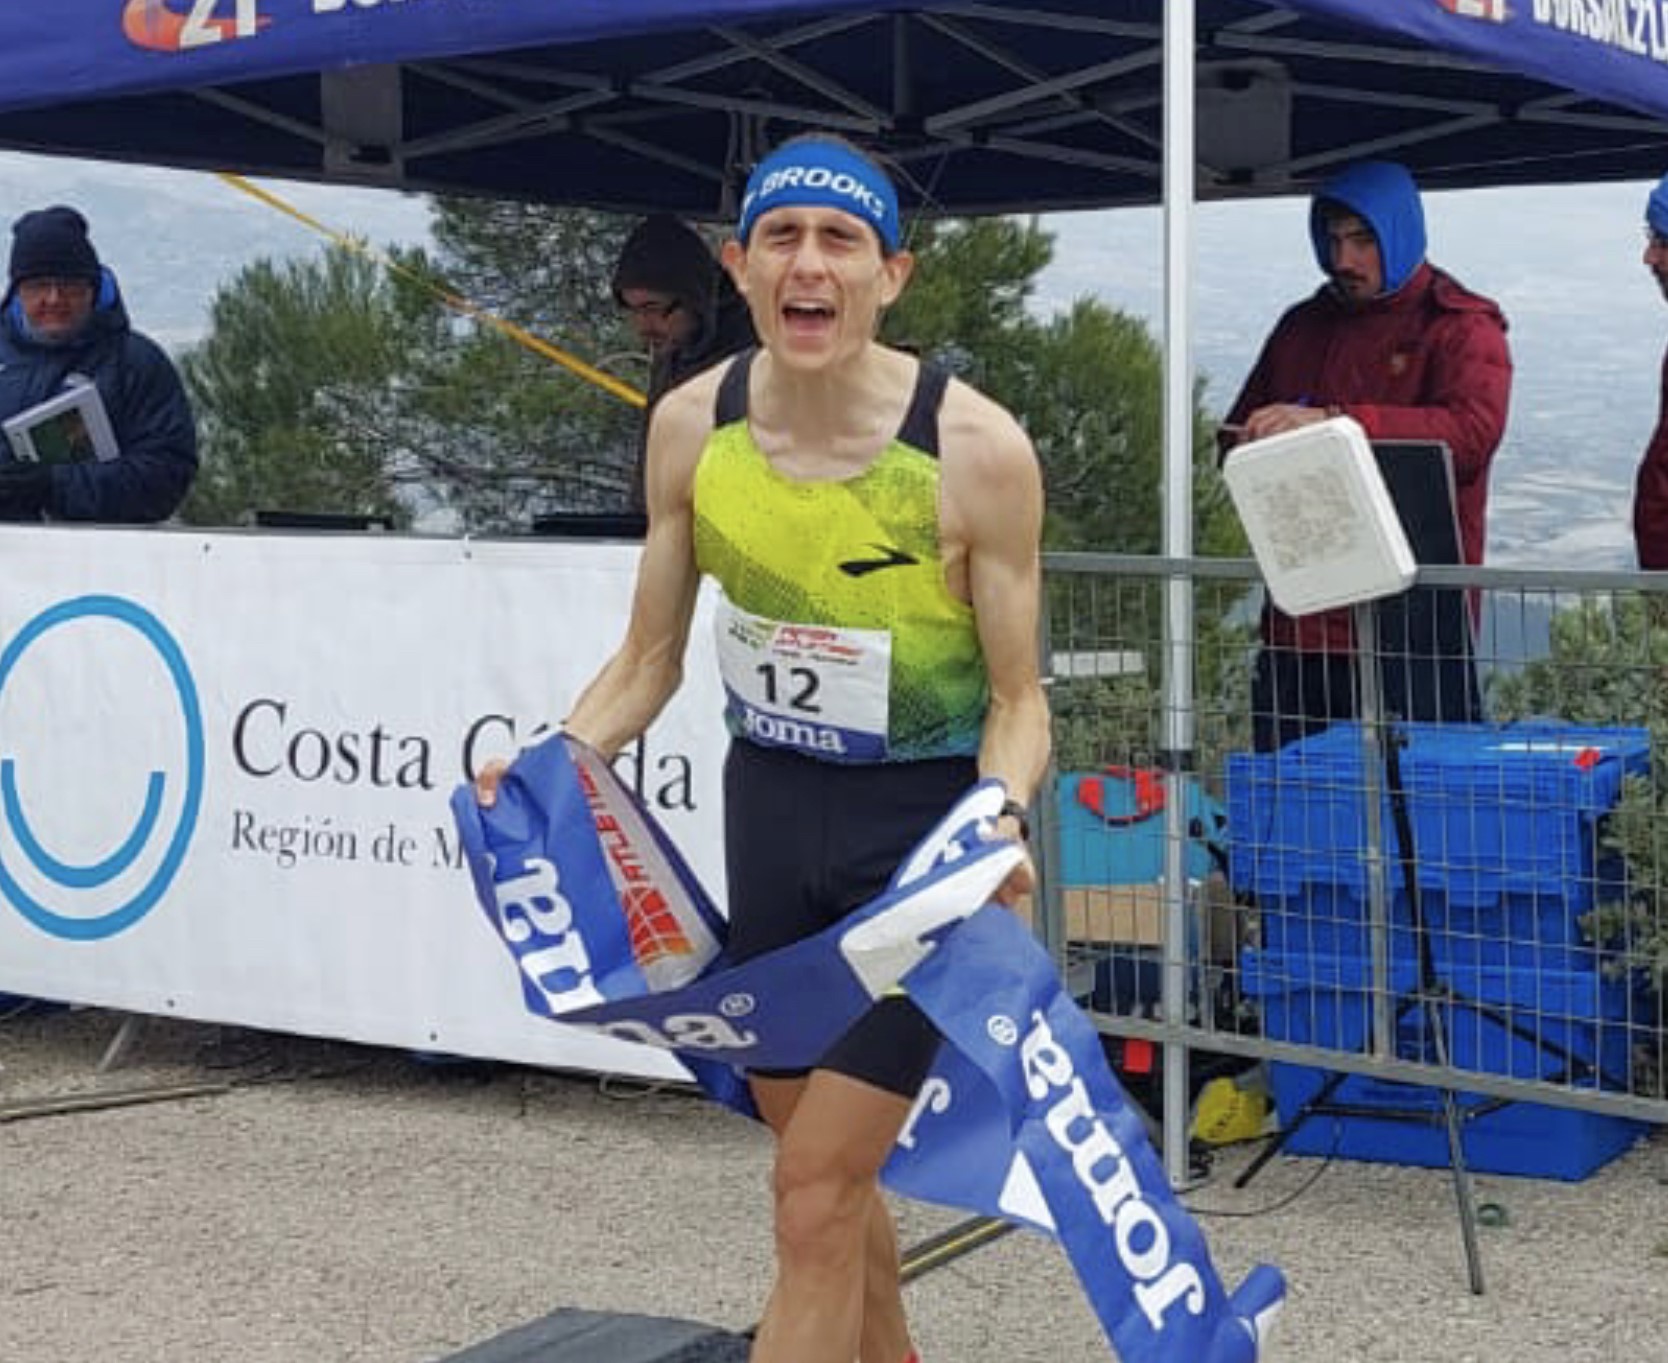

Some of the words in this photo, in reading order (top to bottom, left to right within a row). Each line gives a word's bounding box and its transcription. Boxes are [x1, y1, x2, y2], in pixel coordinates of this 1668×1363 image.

[756, 662, 821, 714] 12
[232, 698, 433, 790] Costa
[461, 714, 697, 812] Cda
[232, 810, 357, 870] Región
[373, 823, 418, 867] de
[1019, 1010, 1204, 1330] Joma
